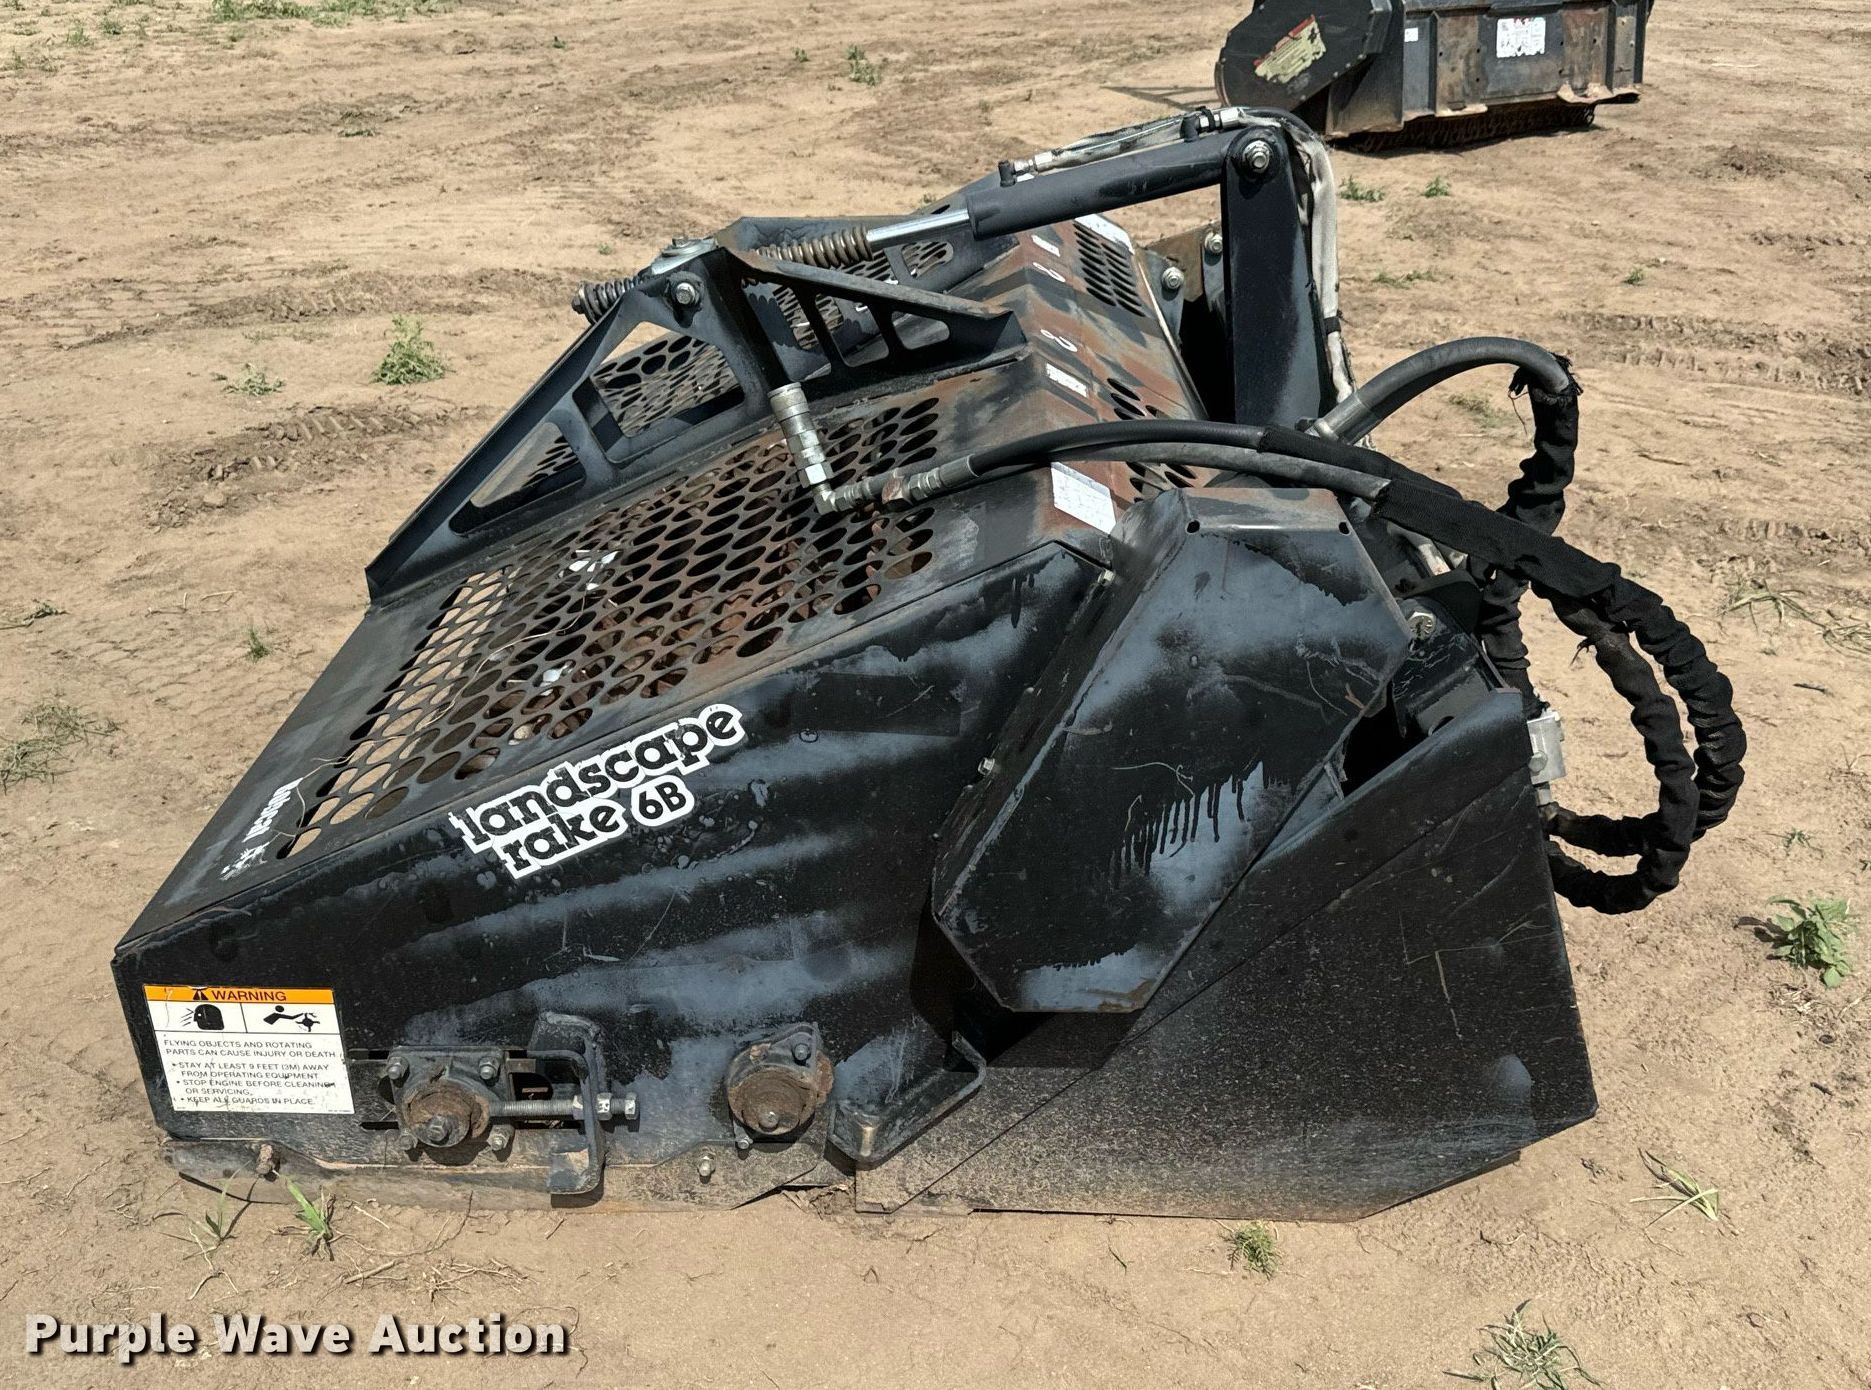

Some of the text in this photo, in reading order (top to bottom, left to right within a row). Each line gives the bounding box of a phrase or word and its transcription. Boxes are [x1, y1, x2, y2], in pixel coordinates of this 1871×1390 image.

[452, 707, 742, 848] landscape
[500, 779, 690, 874] rake 6B
[211, 990, 287, 1001] WARNING
